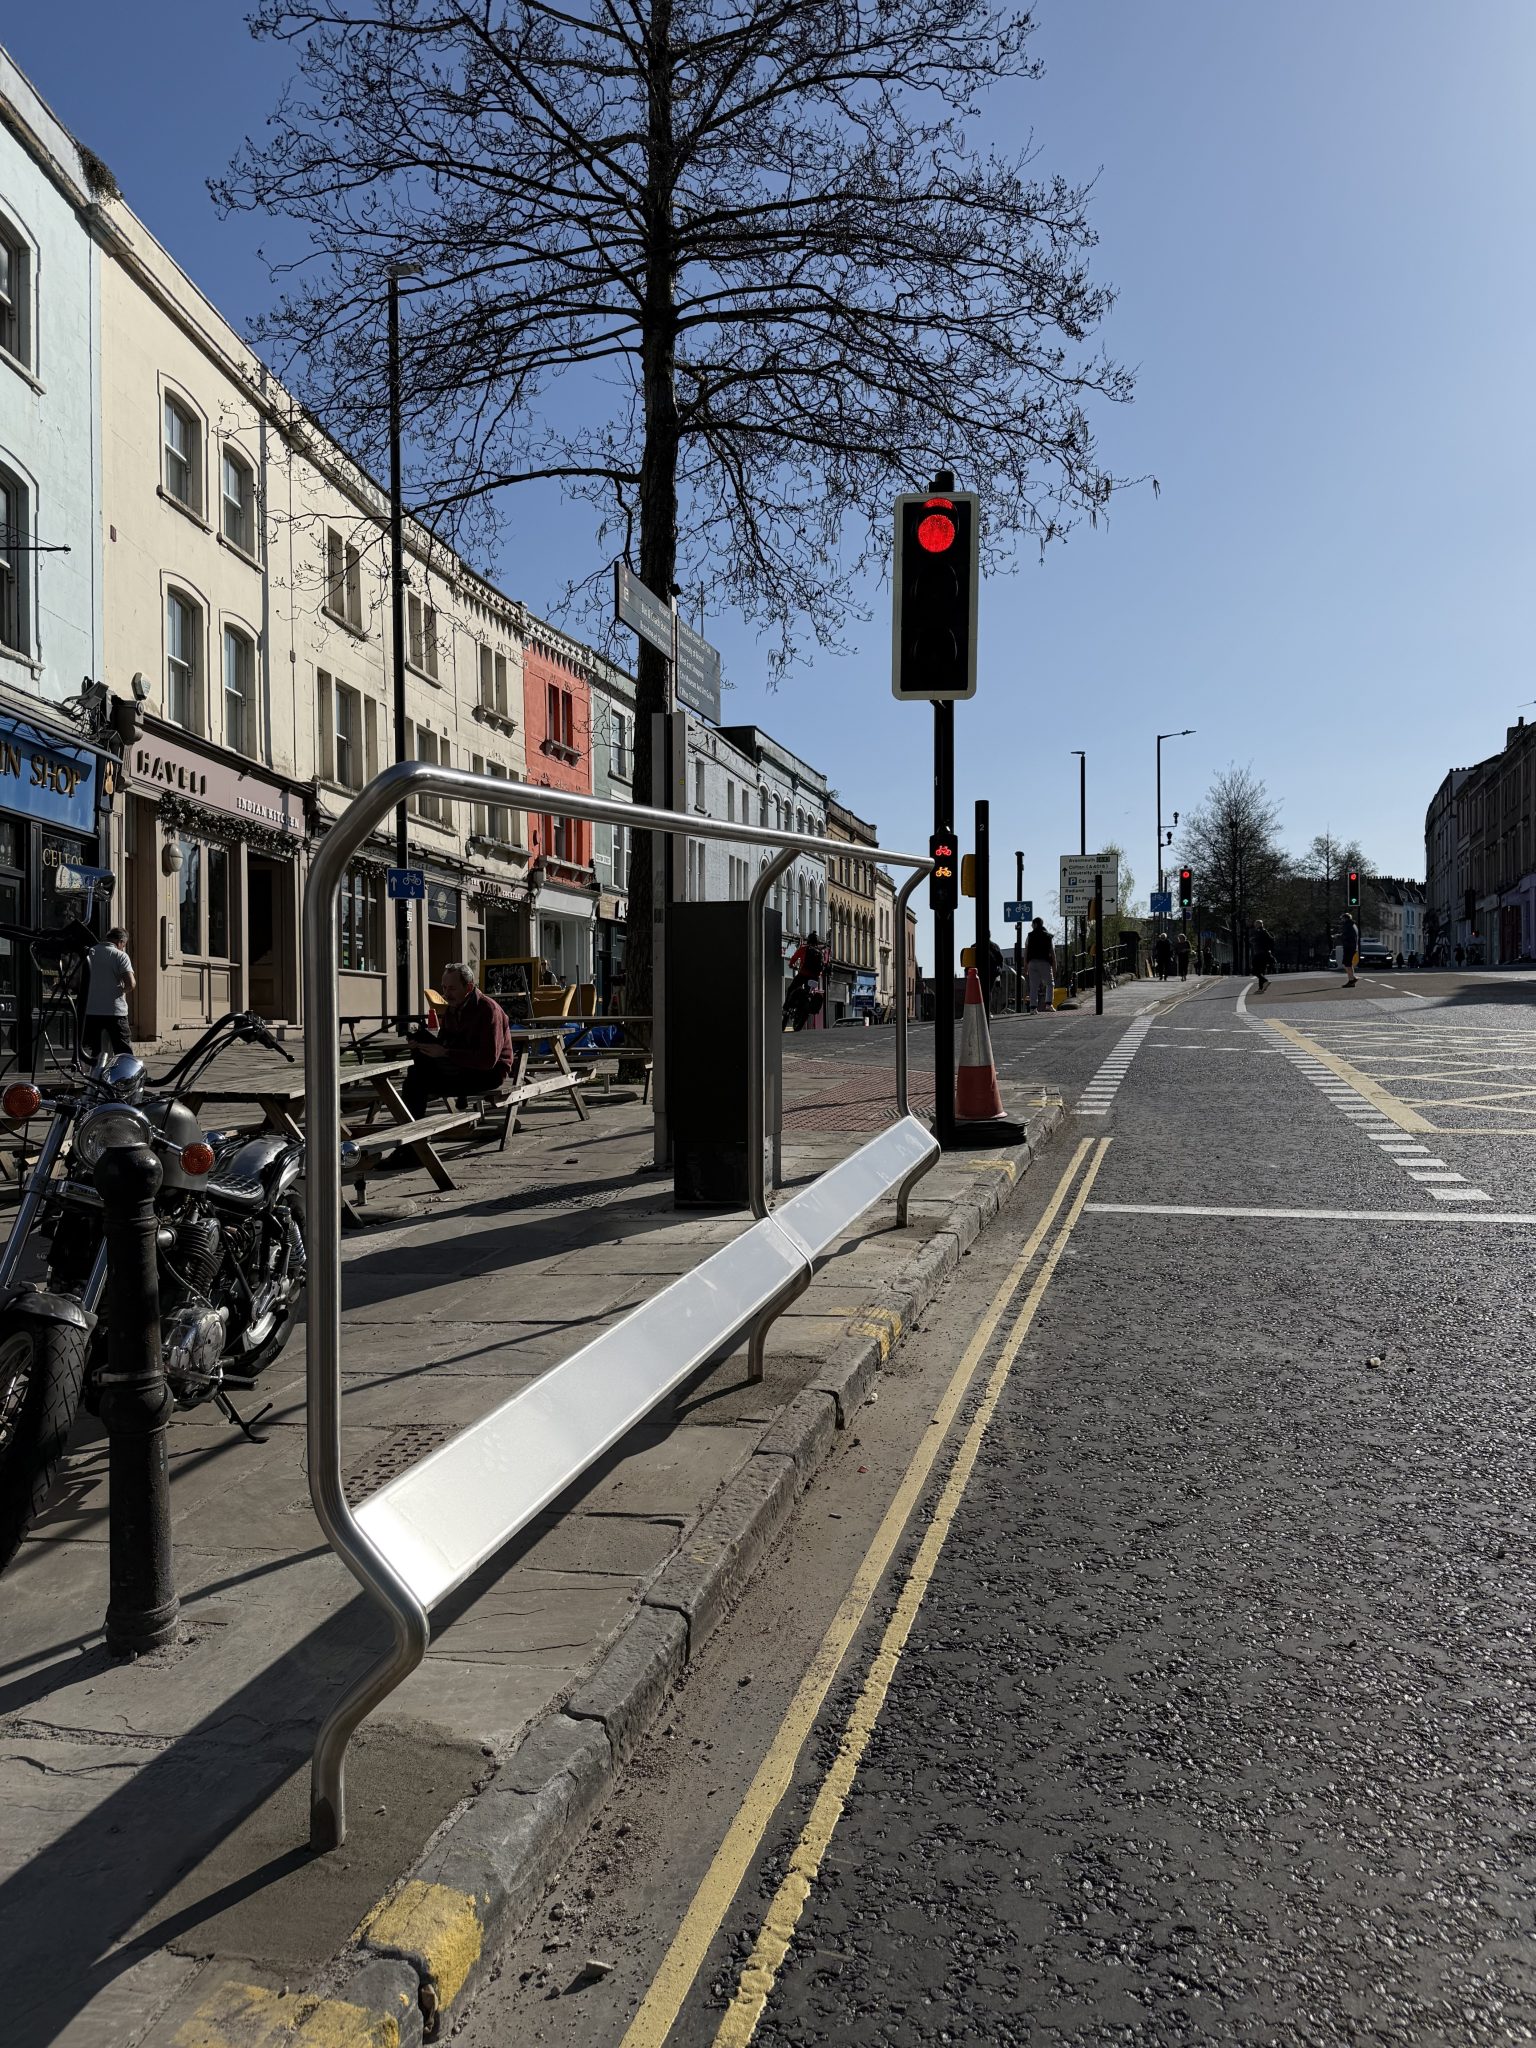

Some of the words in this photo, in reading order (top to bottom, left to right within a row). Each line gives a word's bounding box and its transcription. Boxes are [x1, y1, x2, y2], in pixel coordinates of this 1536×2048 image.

[30, 753, 80, 798] SHOP
[136, 750, 206, 796] HAVELI
[237, 796, 267, 817] INDIAN
[267, 804, 300, 829] KITCHEN
[980, 823, 985, 831] 2
[480, 880, 502, 895] YARD
